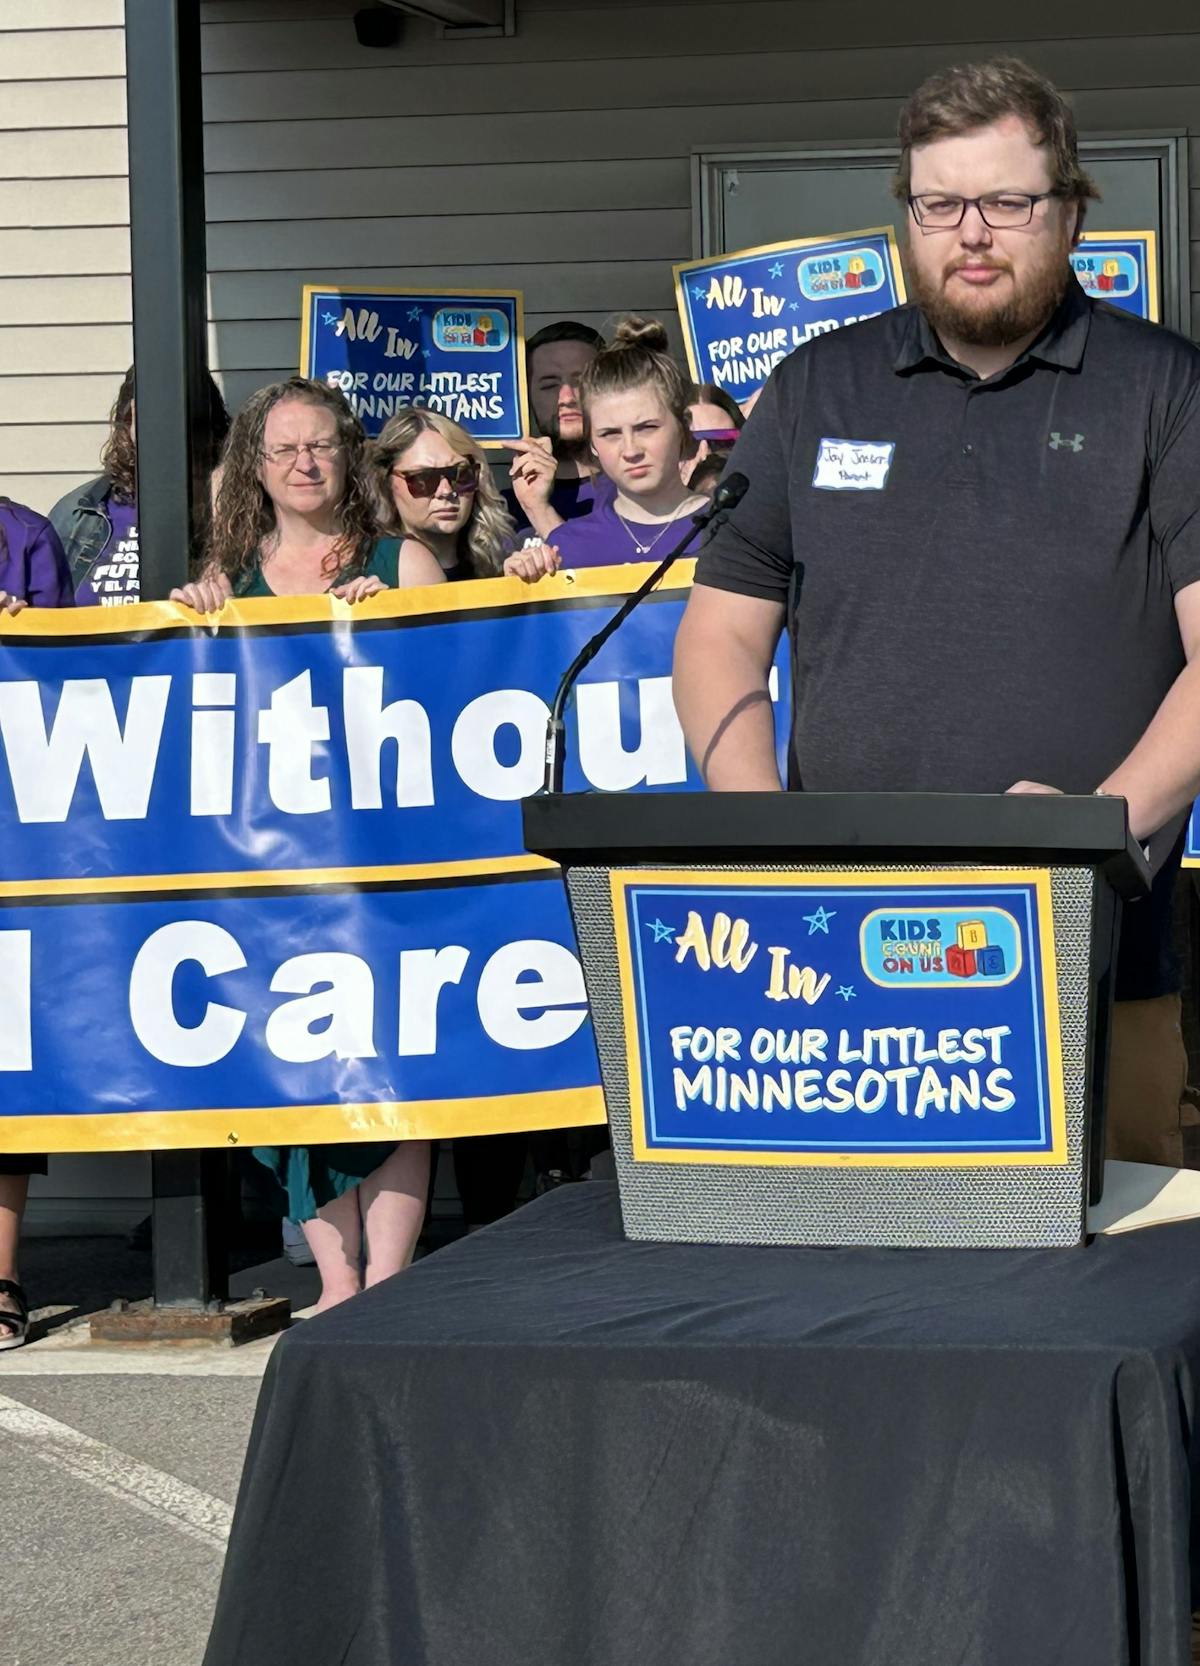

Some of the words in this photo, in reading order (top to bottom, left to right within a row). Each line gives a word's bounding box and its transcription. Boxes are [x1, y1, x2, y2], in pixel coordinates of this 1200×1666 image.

[706, 275, 748, 310] All
[752, 286, 786, 318] In
[335, 307, 382, 341] All
[384, 327, 419, 360] In
[708, 336, 744, 362] FOR
[747, 328, 787, 351] OUR
[327, 370, 367, 392] FOR
[373, 373, 415, 392] OUR
[420, 371, 502, 394] LITTLEST
[91, 581, 102, 593] Y
[104, 580, 123, 592] EL
[0, 666, 688, 823] Withou
[880, 919, 942, 941] KIDS
[881, 940, 942, 957] COUNT
[675, 910, 759, 974] All
[764, 946, 831, 1005] In
[882, 957, 914, 973] ON
[919, 957, 944, 973] US
[128, 920, 590, 1068] Care
[669, 1026, 741, 1063] FOR
[750, 1028, 829, 1065] OUR
[837, 1026, 1011, 1066] LITTLEST
[672, 1065, 1016, 1119] MINNESOTANS
